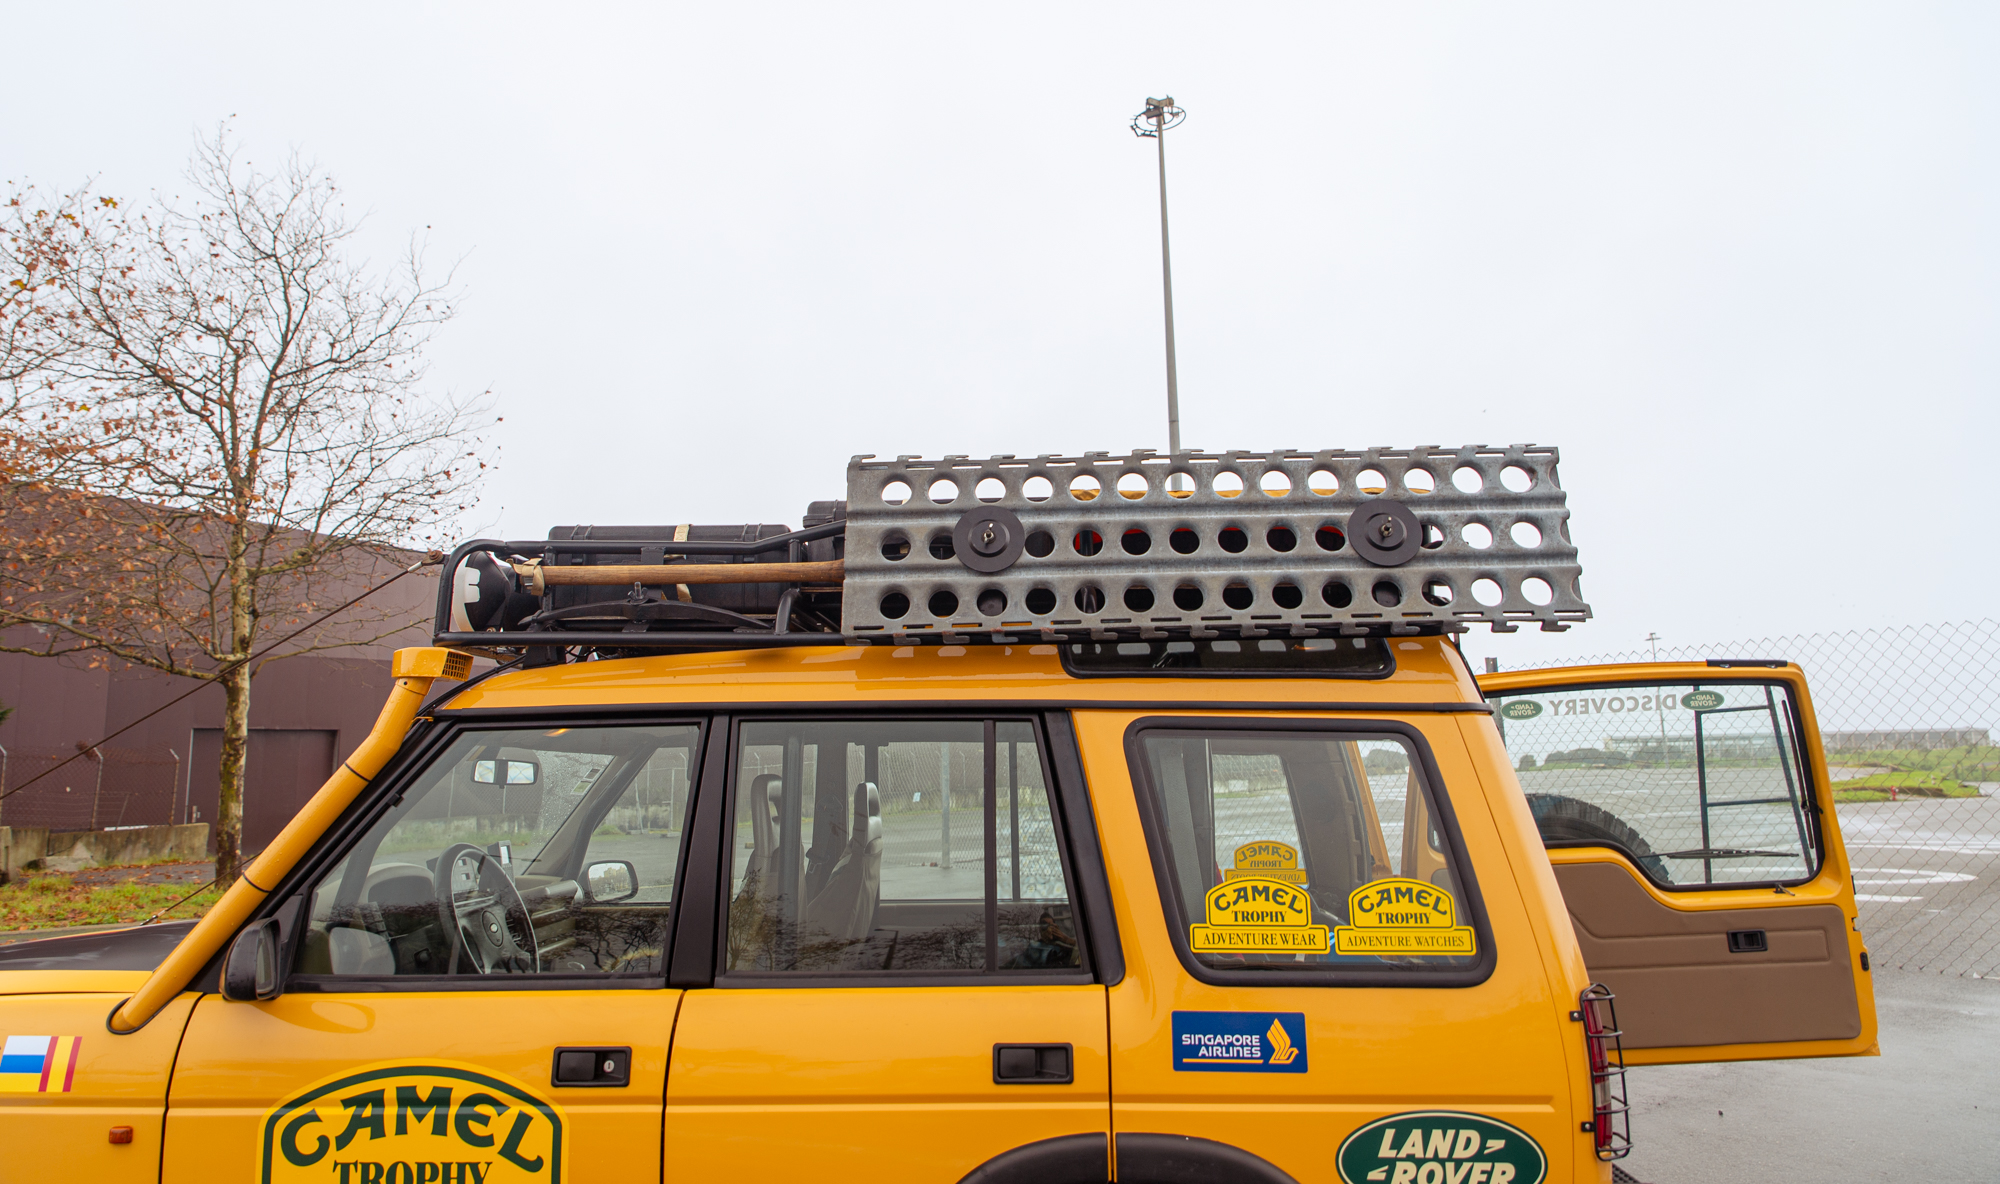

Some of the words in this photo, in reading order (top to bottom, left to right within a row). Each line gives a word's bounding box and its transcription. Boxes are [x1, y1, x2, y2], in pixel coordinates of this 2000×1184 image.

[1213, 885, 1304, 914] CAMEL
[1357, 887, 1448, 916] CAMEL
[1231, 910, 1287, 923] TROPHY
[1375, 912, 1432, 925] TROPHY
[1203, 932, 1277, 946] ADVENTURE
[1277, 933, 1317, 946] WEAR
[1346, 935, 1412, 947] ADVENTURE
[1414, 936, 1465, 948] WATCHES
[1181, 1033, 1260, 1046] SINGAPORE
[1198, 1046, 1261, 1058] AIRLINES
[280, 1085, 544, 1173] CAMEL
[1377, 1129, 1481, 1158] LAND
[332, 1159, 493, 1184] TROPHY
[1394, 1162, 1515, 1184] ROVER
